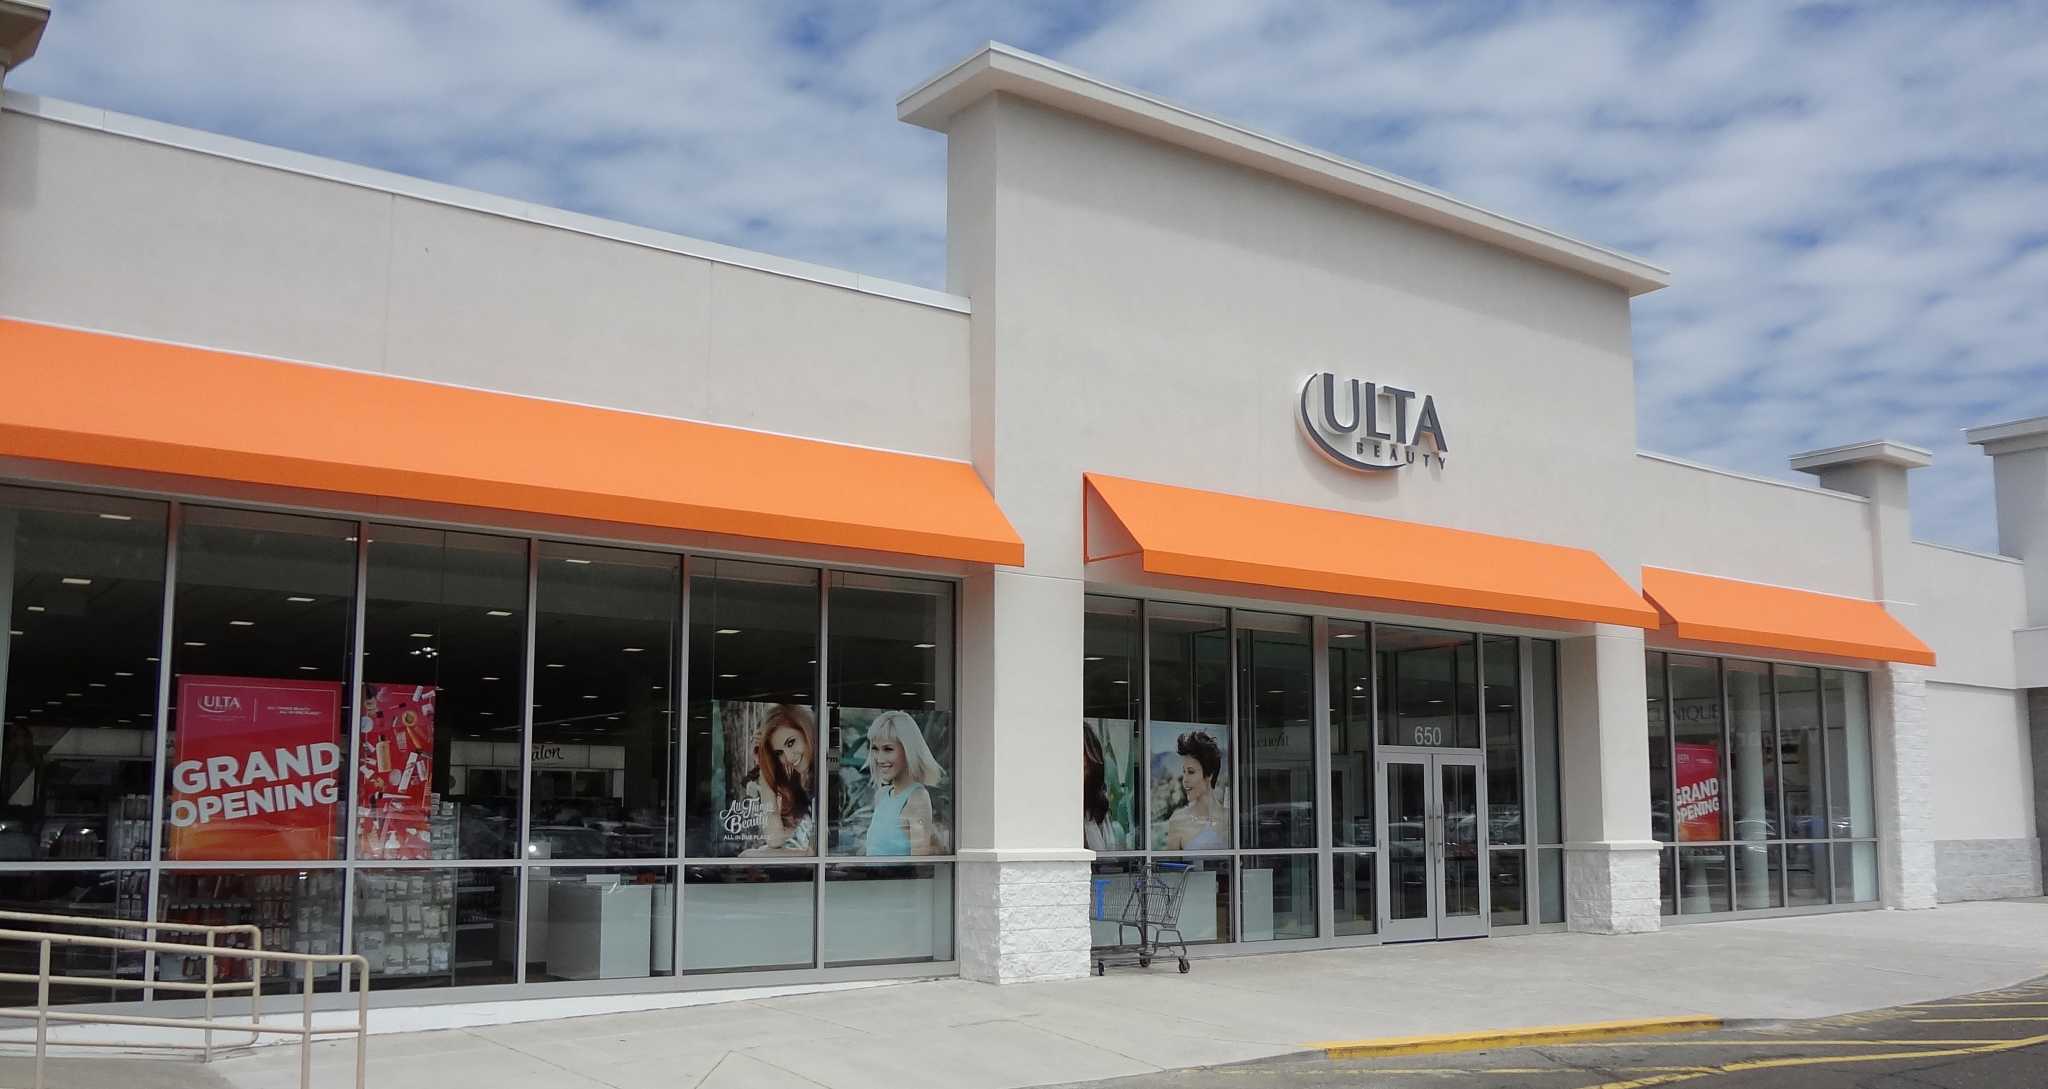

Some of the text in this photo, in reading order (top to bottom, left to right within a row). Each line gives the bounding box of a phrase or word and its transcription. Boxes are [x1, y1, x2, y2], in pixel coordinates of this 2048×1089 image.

[1316, 372, 1448, 452] ULTA
[1356, 441, 1446, 470] BEAUTY
[203, 695, 241, 708] ULTA
[1648, 704, 1721, 722] CLNIQUE
[1414, 725, 1442, 746] 650
[531, 744, 565, 761] alon
[172, 742, 341, 794] GRAND
[170, 777, 339, 827] OPENING
